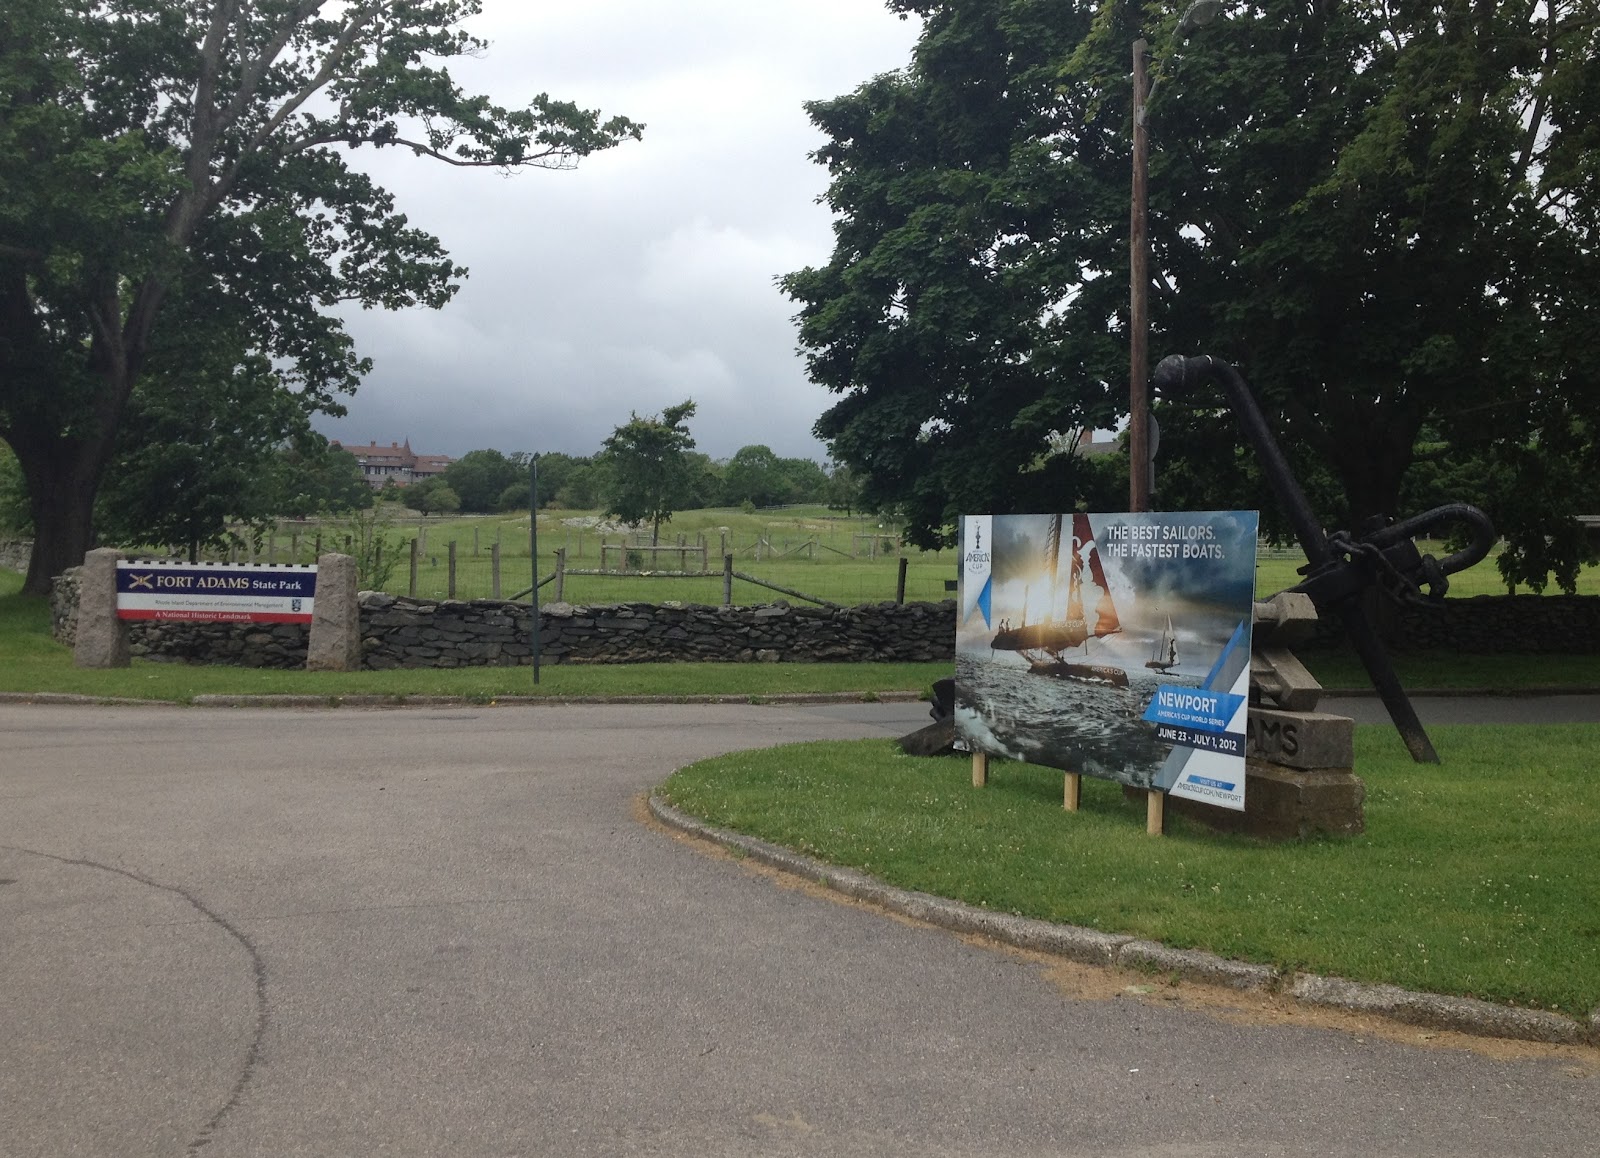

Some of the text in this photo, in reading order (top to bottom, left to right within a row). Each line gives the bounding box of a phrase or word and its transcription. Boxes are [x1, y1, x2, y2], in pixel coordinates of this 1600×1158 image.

[1107, 525, 1216, 540] THE BEST SAILORS.
[1106, 543, 1225, 559] THE FASTEST BOATS.
[156, 575, 301, 590] FORT ADAMS State Park
[1158, 691, 1217, 713] NEWPORT
[1157, 710, 1181, 720] AMERICA'S
[1191, 715, 1208, 724] WORLD
[1208, 718, 1225, 727] SERIES
[1158, 727, 1177, 740] JUNE
[1178, 730, 1187, 741] 23
[1192, 733, 1211, 746] JULY
[1211, 737, 1218, 749] 1,
[1218, 738, 1237, 751] 2012
